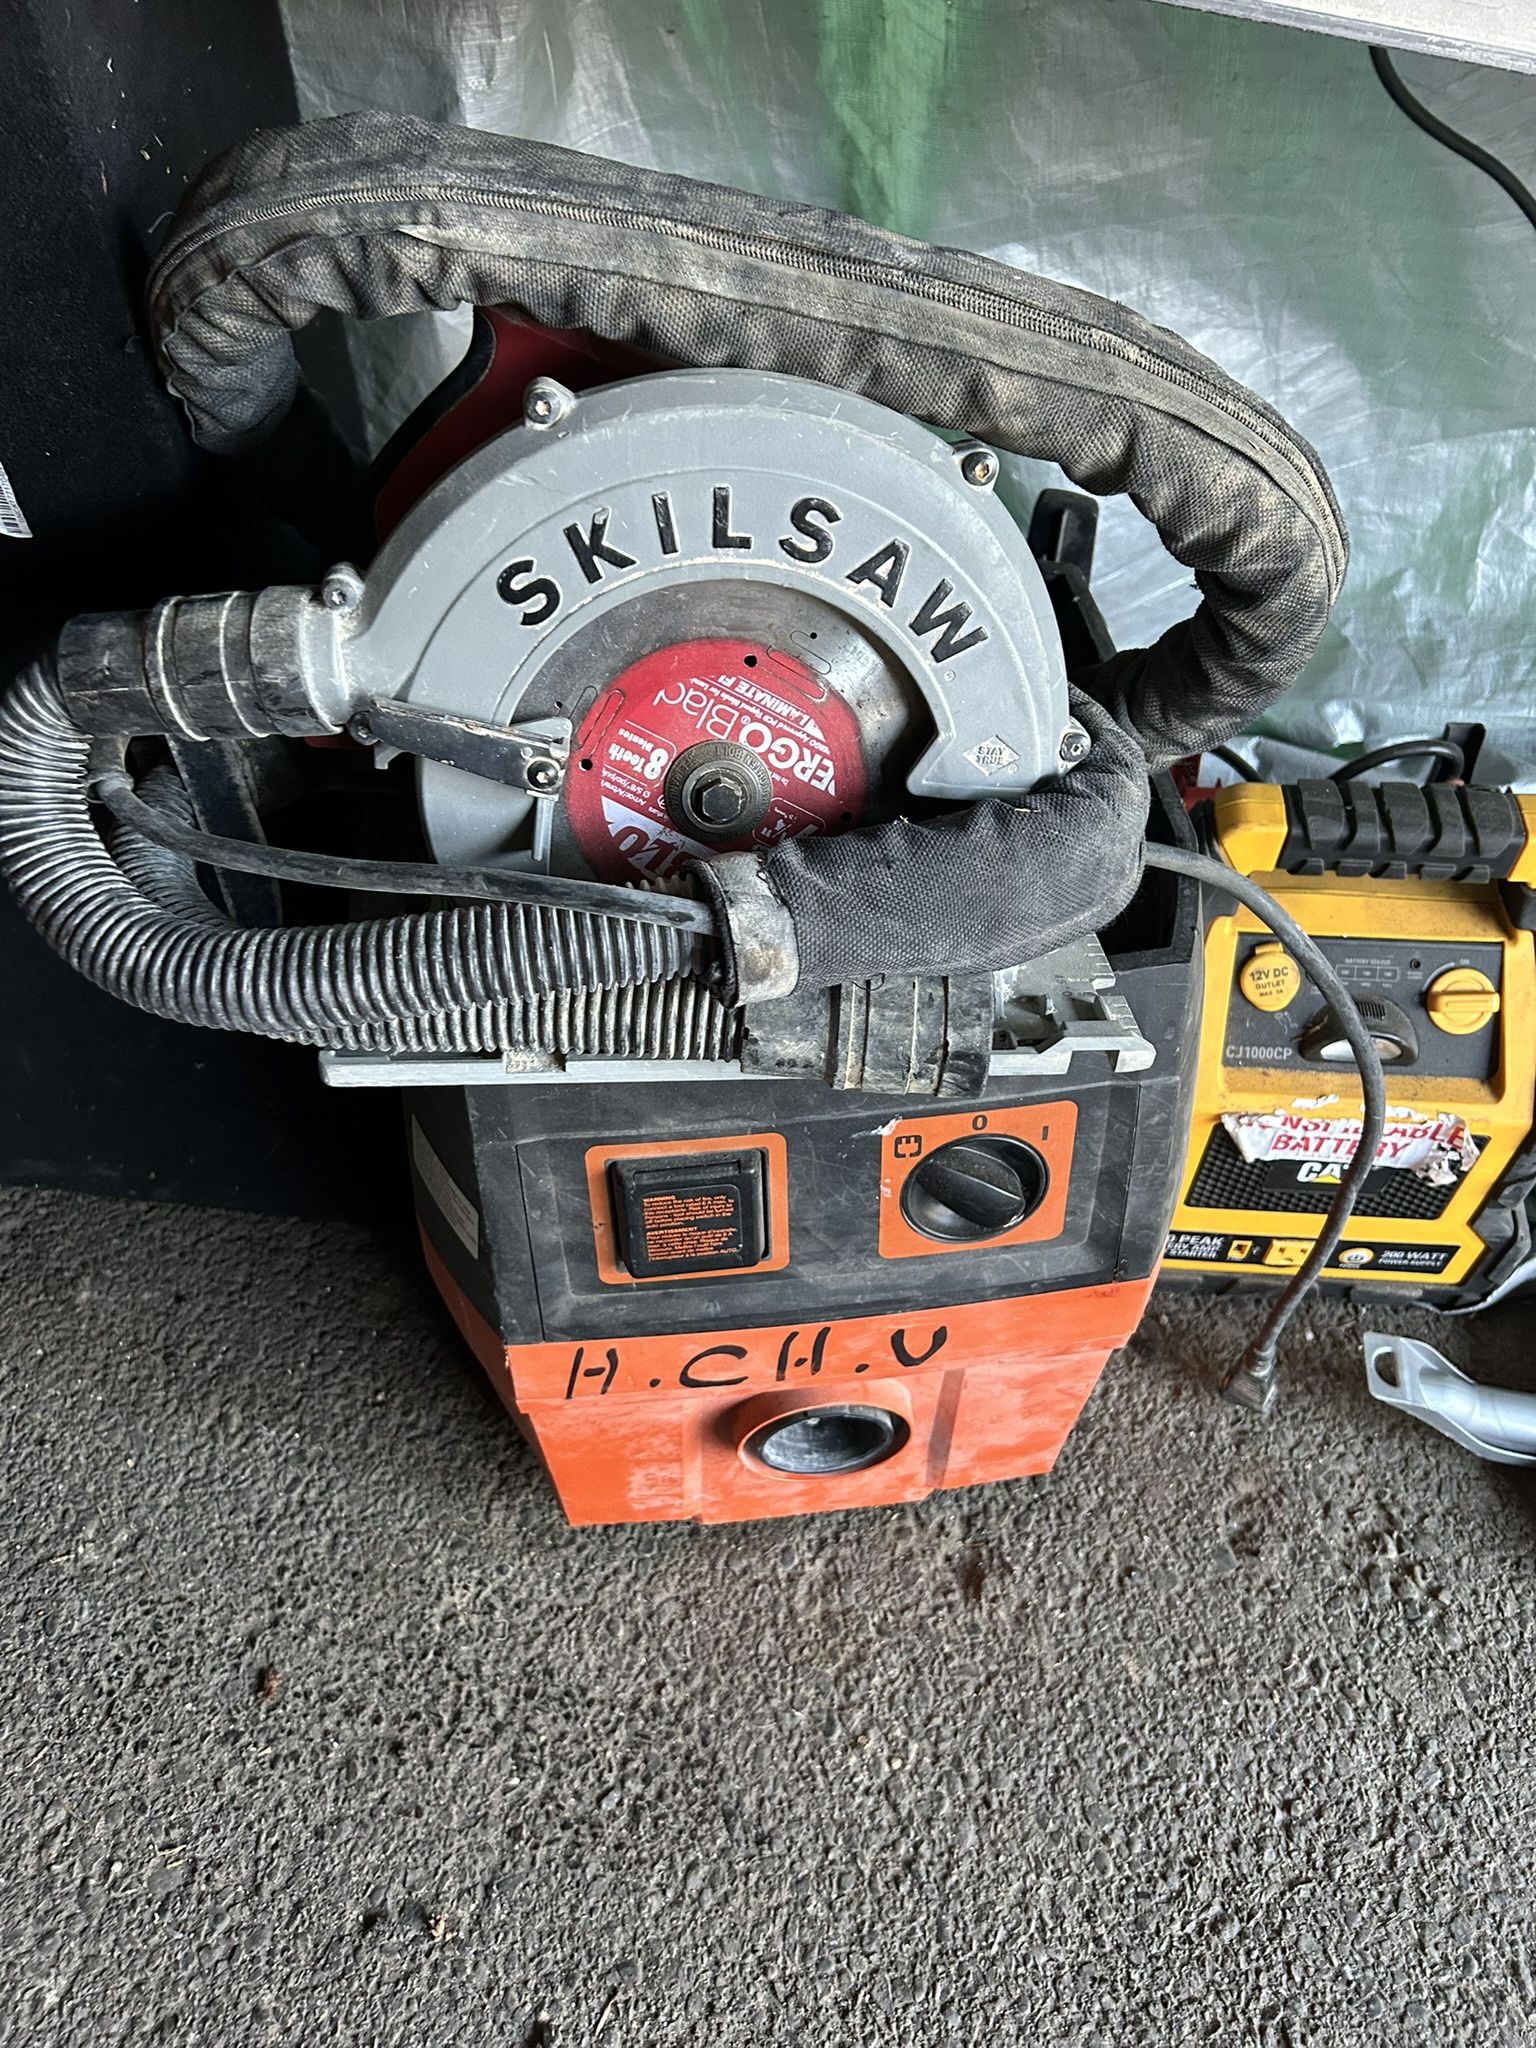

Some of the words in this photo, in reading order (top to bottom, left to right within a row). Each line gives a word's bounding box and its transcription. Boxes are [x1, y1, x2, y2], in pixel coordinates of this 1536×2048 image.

[497, 486, 989, 665] SKILSAW
[734, 677, 809, 727] LAMINATE
[616, 728, 654, 752] Dientes
[605, 742, 646, 772] Teeth
[977, 746, 1005, 756] STAY
[645, 747, 669, 781] 8
[976, 755, 1004, 765] TRUE
[1250, 969, 1270, 982] 12V
[1273, 967, 1289, 977] DC
[1256, 980, 1285, 990] OUTLET
[1226, 1045, 1293, 1060] CJ1000CP
[1297, 1162, 1348, 1183] CA
[1179, 1234, 1224, 1245] PEAK
[1170, 1249, 1217, 1259] STARTER
[1407, 1251, 1448, 1260] WATT
